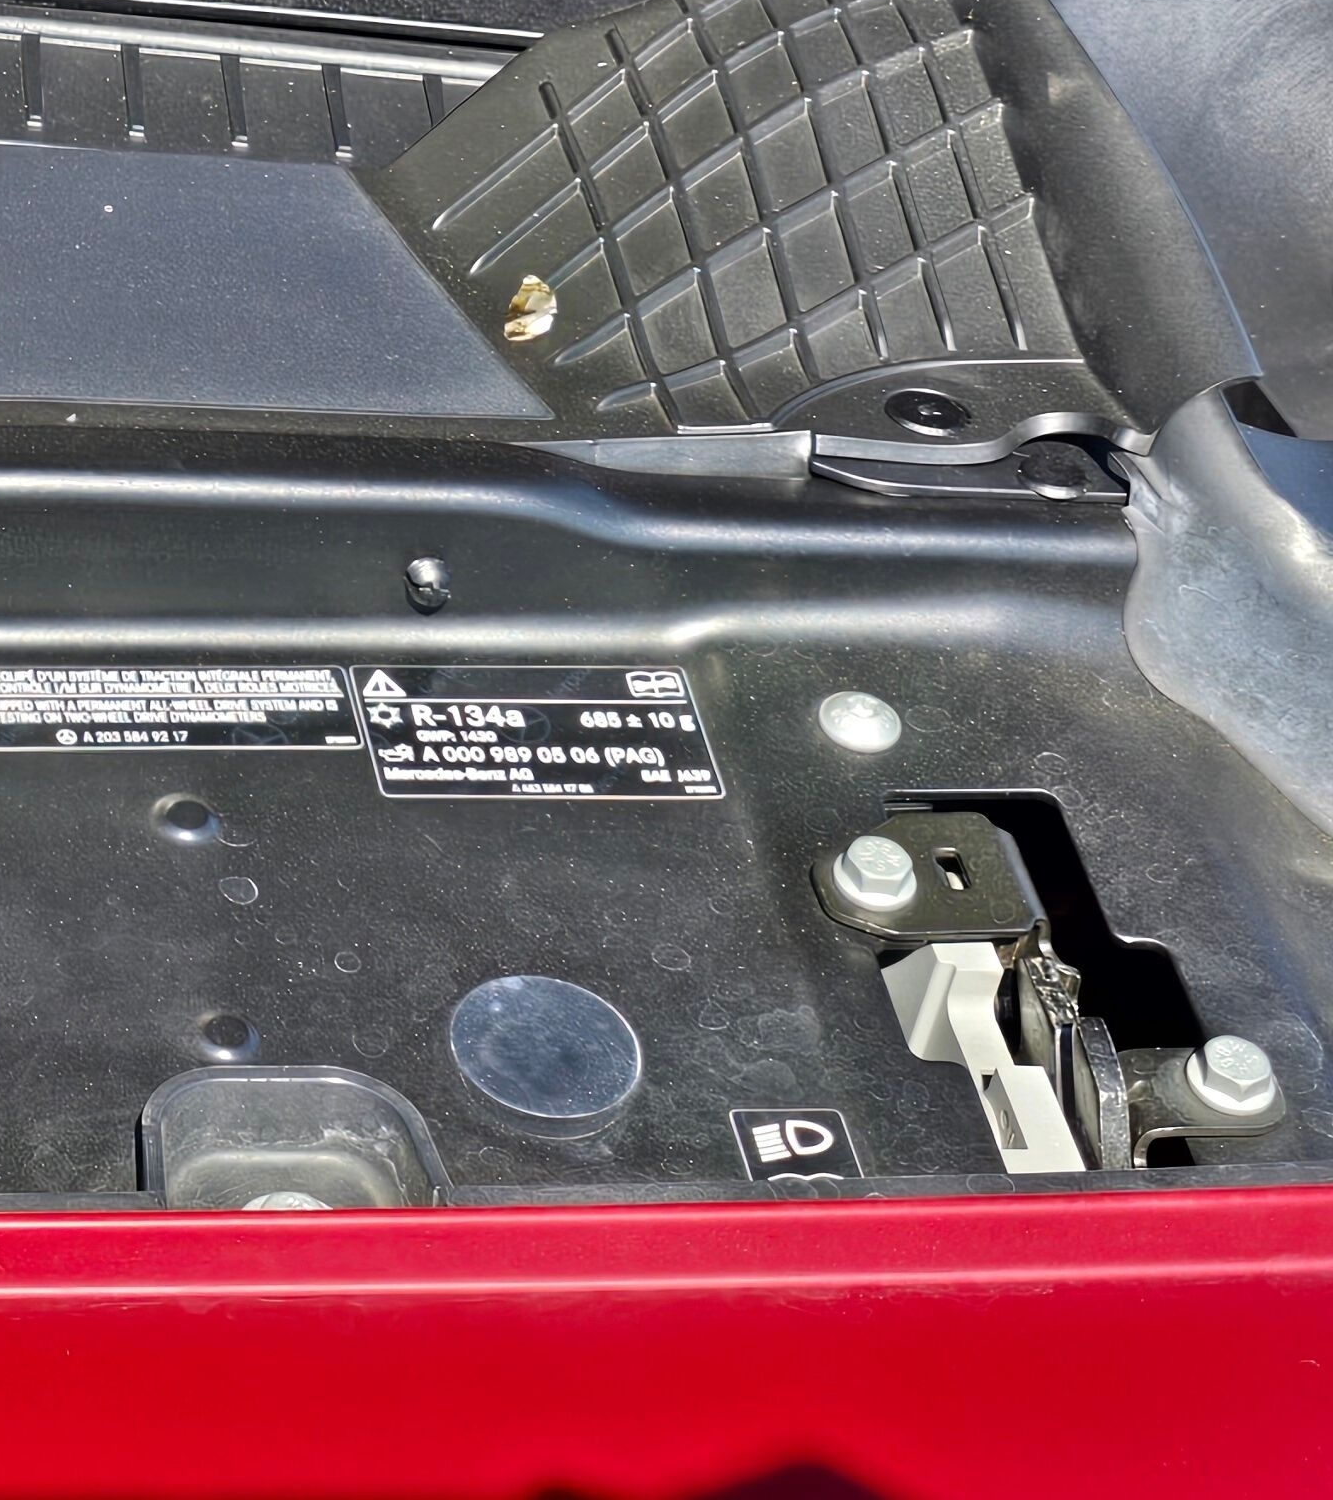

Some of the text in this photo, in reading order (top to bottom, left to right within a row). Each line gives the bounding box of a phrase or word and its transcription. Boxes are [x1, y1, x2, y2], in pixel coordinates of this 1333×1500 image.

[33, 699, 65, 712] WITH
[77, 699, 147, 712] PERMANENT
[213, 699, 249, 712] DRIVE
[251, 699, 298, 712] SYSTEM
[299, 699, 324, 712] AND
[133, 710, 169, 723] DRIVE
[411, 704, 526, 728] R-134a
[580, 711, 623, 729] 685
[648, 712, 676, 729] 10
[83, 731, 189, 743] A 203 584 92 17
[422, 746, 665, 767] A 000 989 05 06 (PAG)
[383, 767, 535, 782] Mercedes-Benz AG
